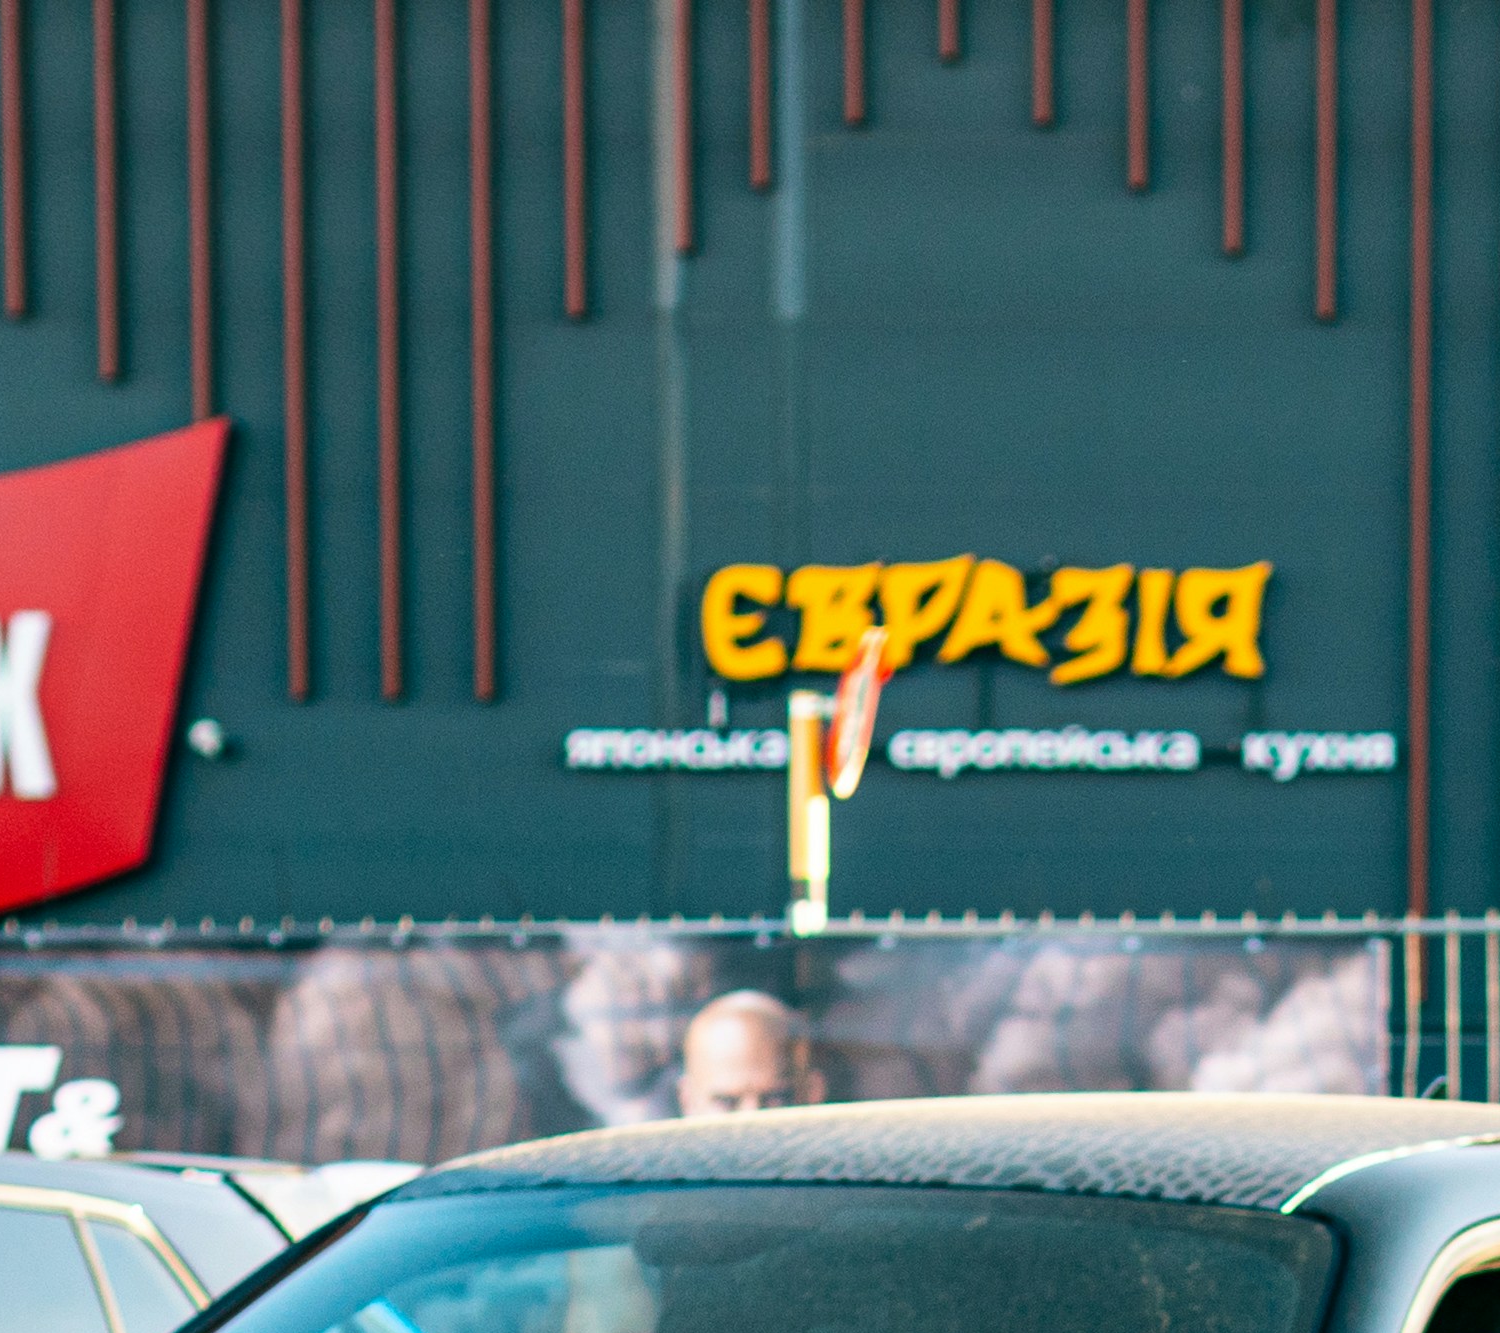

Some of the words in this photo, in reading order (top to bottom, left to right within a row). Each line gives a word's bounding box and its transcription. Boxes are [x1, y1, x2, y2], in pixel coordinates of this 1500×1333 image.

[702, 552, 1274, 686] ЄВРАЗІЯ
[886, 723, 1201, 779] європейська
[1242, 731, 1397, 783] кухня
[27, 1076, 124, 1162] &
